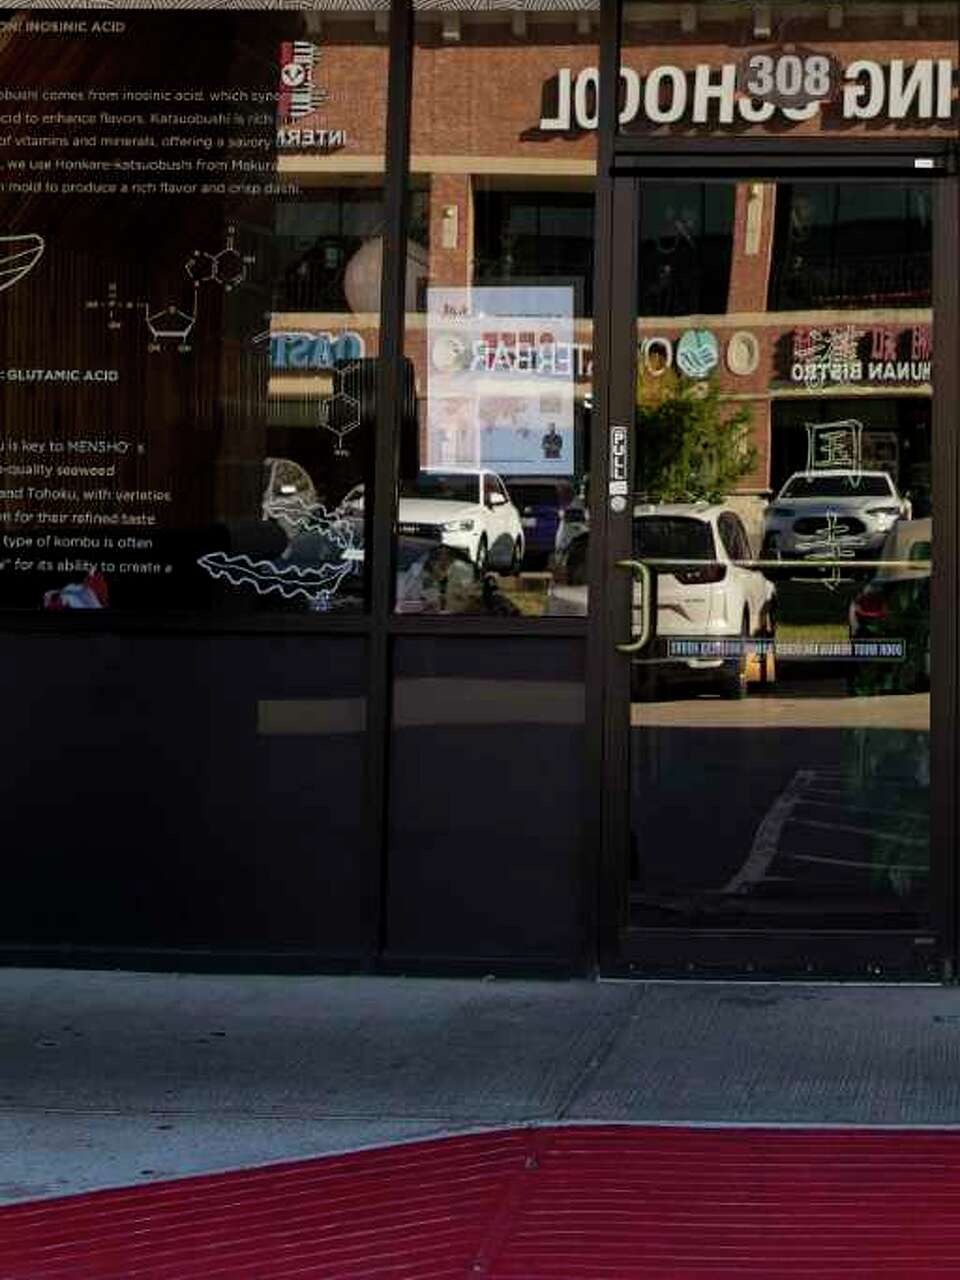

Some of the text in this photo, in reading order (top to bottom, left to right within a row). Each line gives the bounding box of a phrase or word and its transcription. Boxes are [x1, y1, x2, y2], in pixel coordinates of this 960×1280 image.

[91, 20, 127, 33] ACID
[747, 54, 832, 96] 308
[43, 91, 84, 101] comes
[88, 88, 119, 101] from
[210, 89, 249, 101] which
[25, 114, 39, 124] to
[42, 113, 97, 124] enhance
[15, 135, 70, 146] vitamins
[73, 135, 97, 146] and
[161, 135, 213, 150] offering
[8, 161, 25, 170] we
[29, 161, 51, 170] use
[196, 159, 228, 171] from
[46, 182, 59, 192] to
[62, 182, 117, 195] produce
[132, 182, 157, 193] rich
[160, 182, 198, 193] flavor
[201, 182, 227, 193] and
[7, 369, 120, 382] GLUTAMIC ACID
[22, 440, 46, 455] key
[50, 440, 65, 452] to
[58, 464, 116, 477] seaweed
[0, 489, 24, 500] and
[83, 489, 112, 501] with
[116, 489, 172, 502] varieties
[15, 511, 33, 524] for
[38, 512, 70, 524] their
[73, 513, 119, 524] refined
[3, 535, 153, 549] type of kombu is often
[15, 558, 34, 571] for
[101, 561, 116, 573] to
